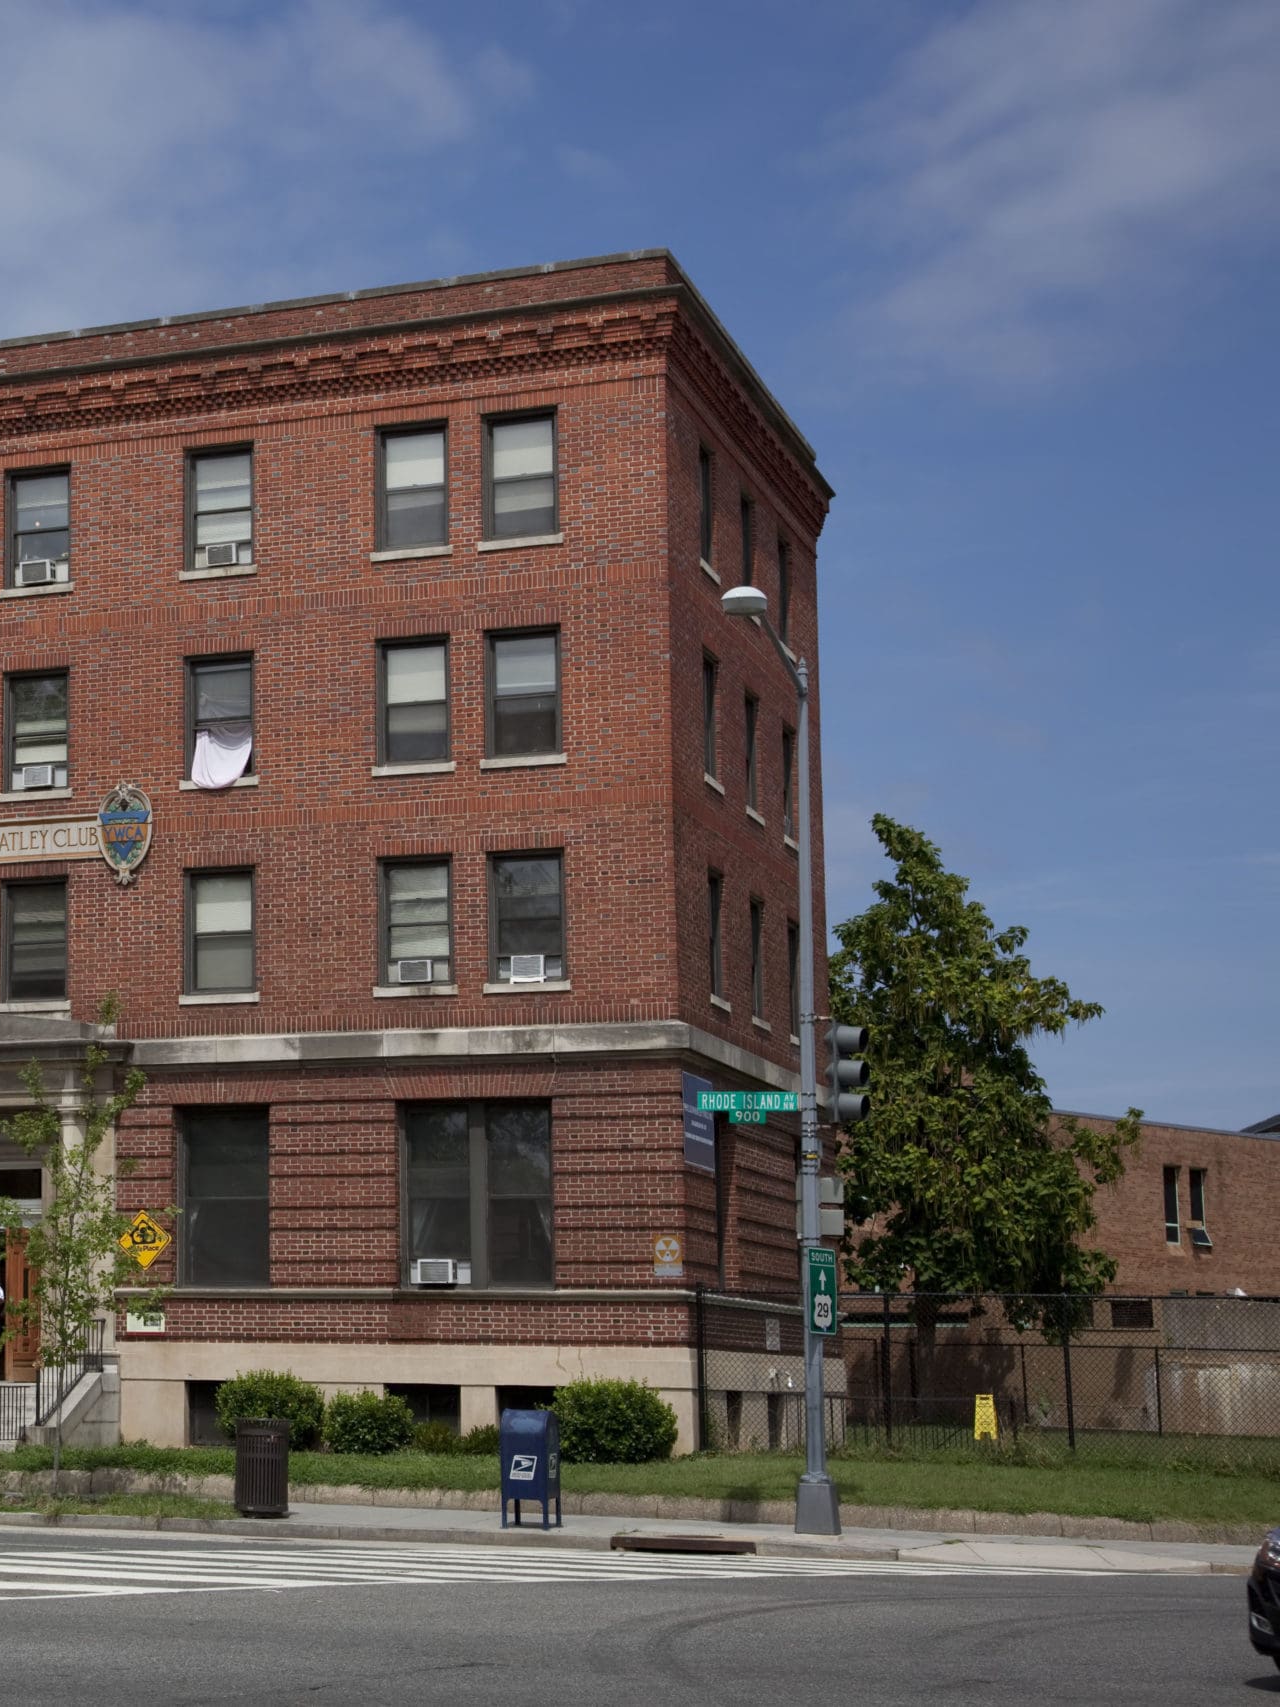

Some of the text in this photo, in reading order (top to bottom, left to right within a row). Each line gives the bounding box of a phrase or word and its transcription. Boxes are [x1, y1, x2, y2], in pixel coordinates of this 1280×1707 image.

[53, 826, 98, 848] CLUB
[104, 826, 145, 842] YWCA
[702, 1094, 737, 1109] RHODE
[743, 1094, 781, 1109] ISLAND
[783, 1102, 795, 1110] NW
[735, 1111, 760, 1122] 900
[811, 1252, 833, 1263] SOUTH
[817, 1302, 829, 1319] 29
